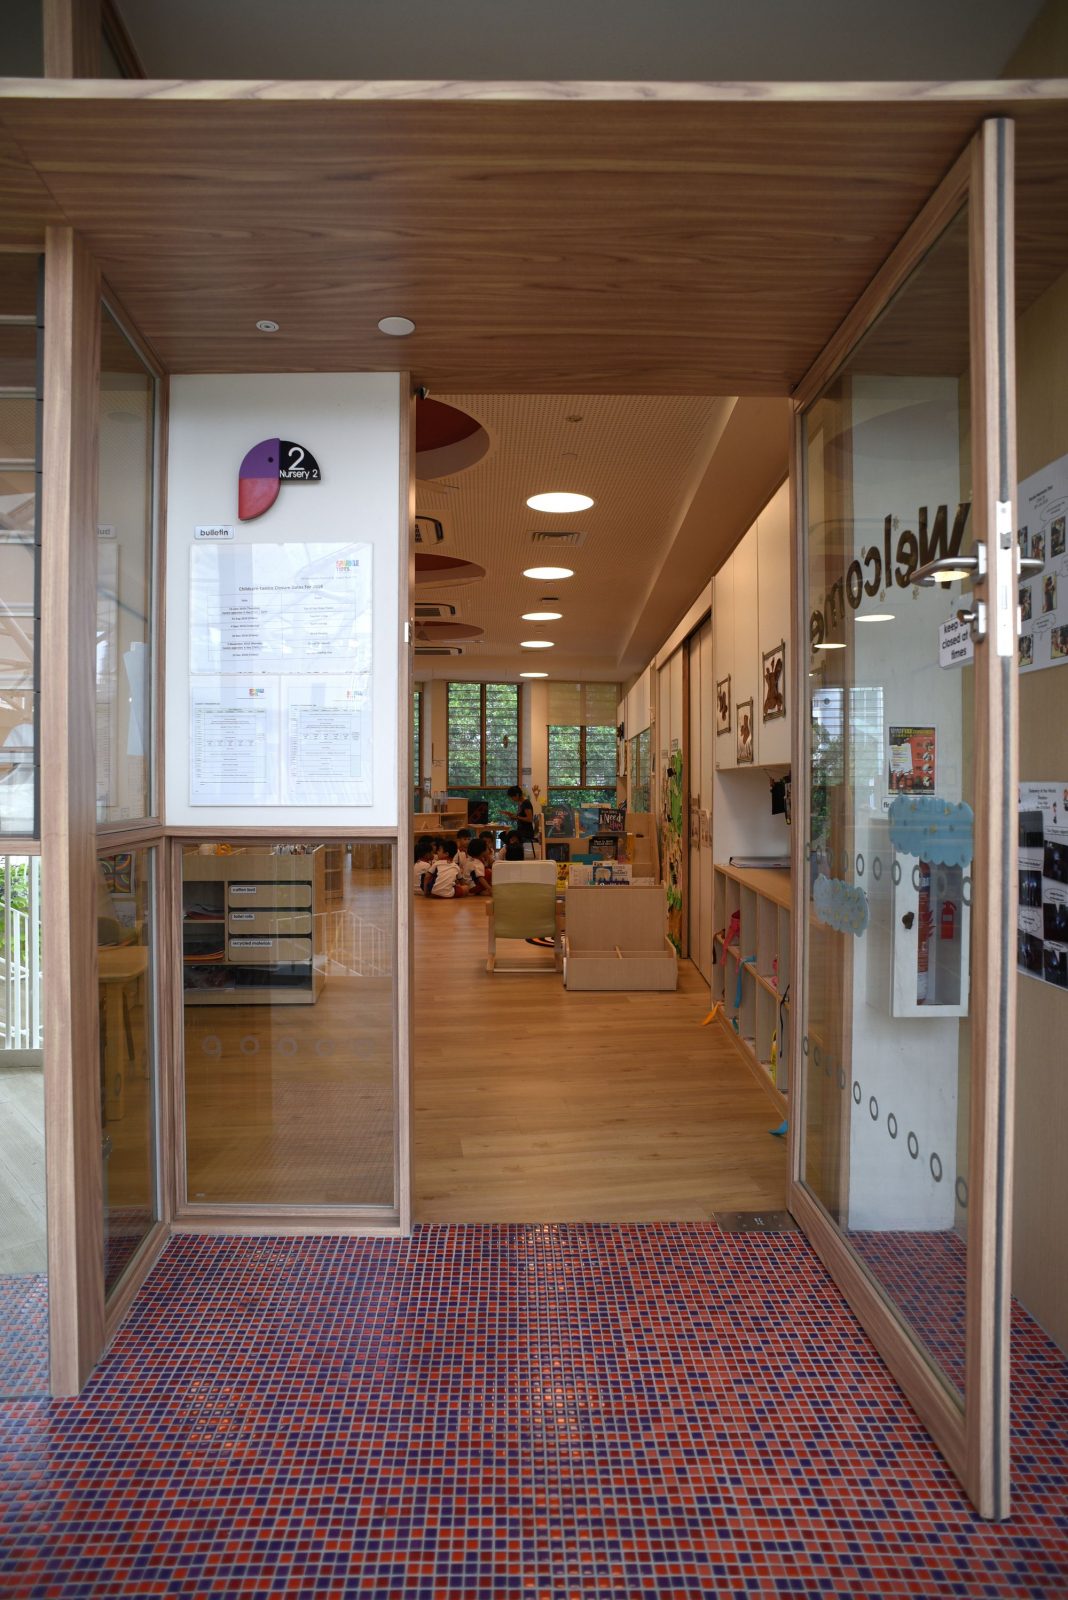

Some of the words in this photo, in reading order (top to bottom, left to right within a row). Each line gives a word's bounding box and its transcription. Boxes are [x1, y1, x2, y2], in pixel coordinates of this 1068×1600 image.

[288, 447, 305, 470] 2
[279, 470, 310, 480] Nursery
[312, 469, 318, 478] 2
[200, 529, 229, 537] bulletin
[943, 620, 959, 634] keep
[942, 633, 961, 650] closed
